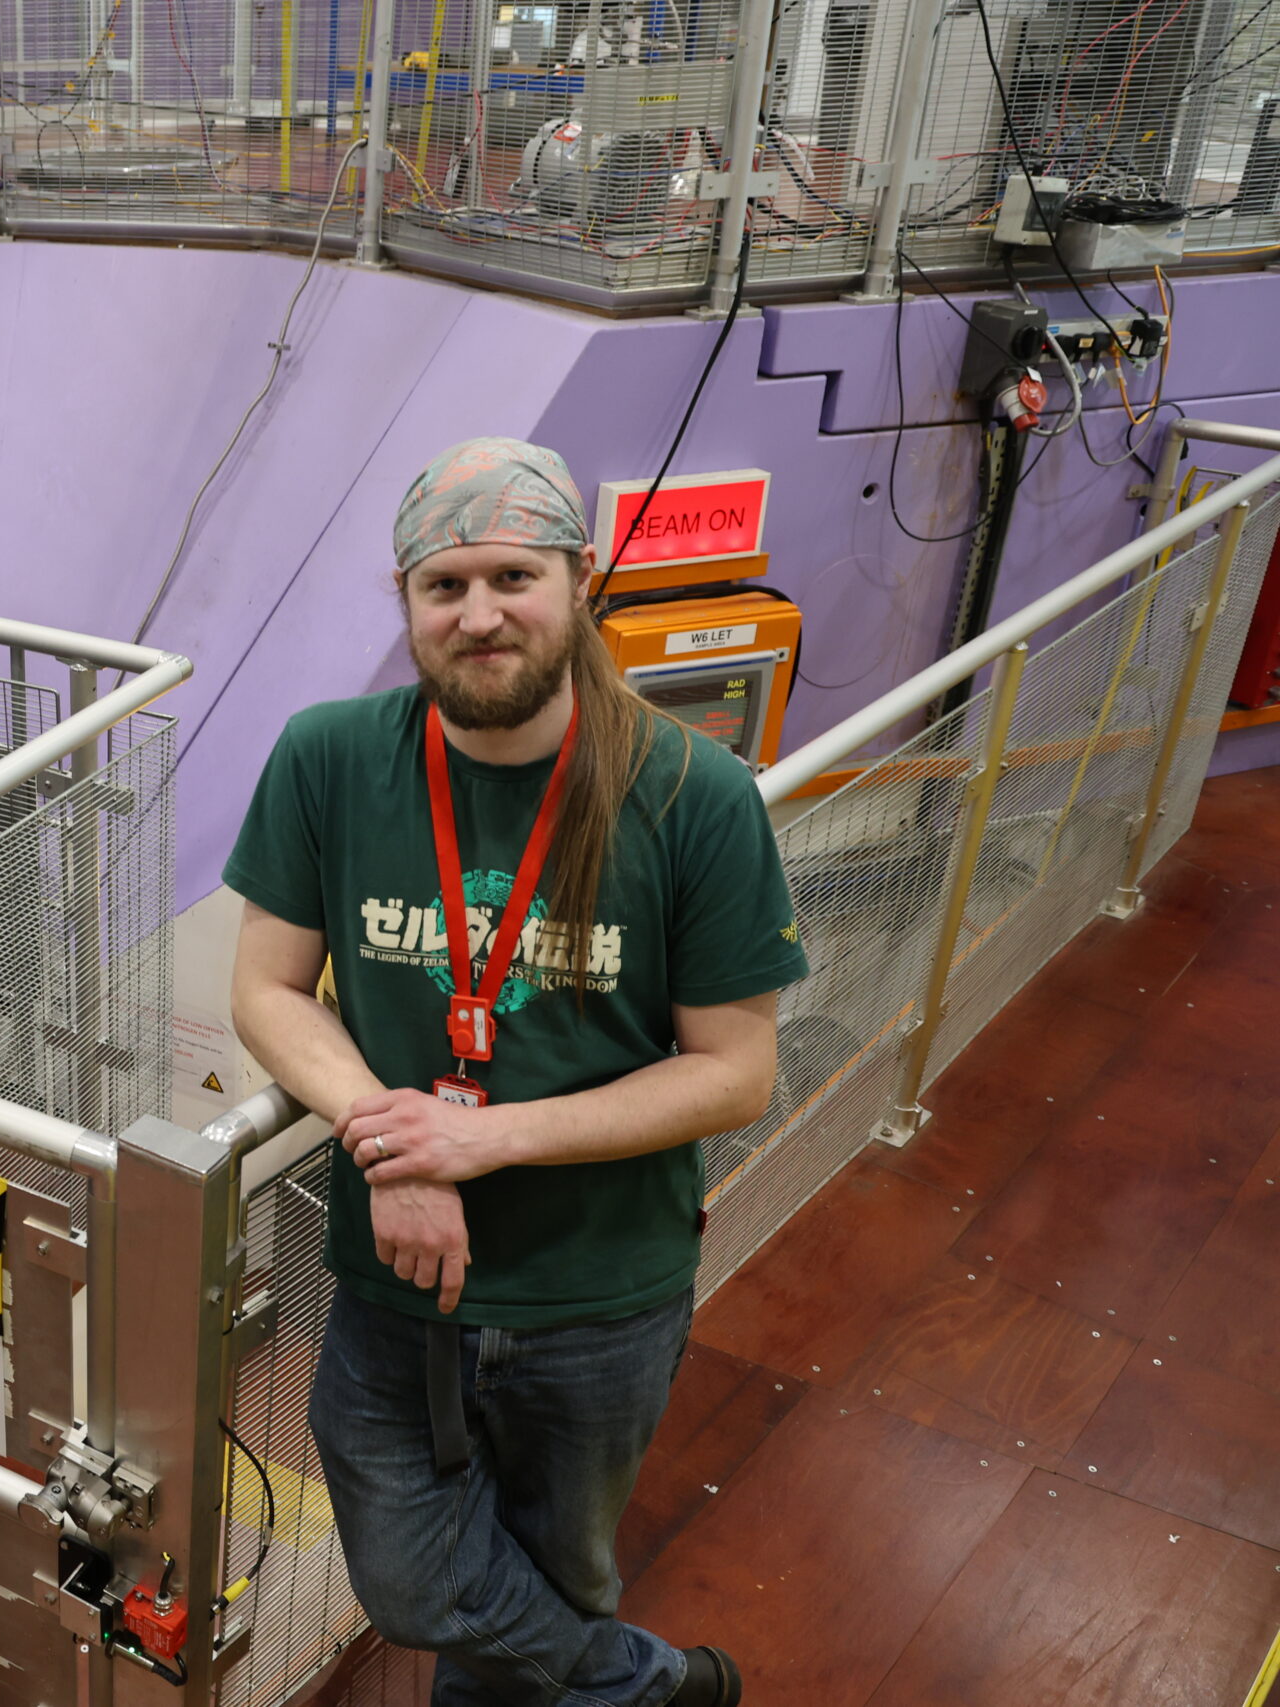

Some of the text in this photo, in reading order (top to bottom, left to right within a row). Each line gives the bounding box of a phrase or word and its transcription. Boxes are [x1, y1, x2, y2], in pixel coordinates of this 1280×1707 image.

[630, 507, 746, 540] BEAM ON
[691, 629, 734, 644] W6 LET
[727, 679, 746, 689] RAD
[724, 689, 746, 700] HIGH
[359, 948, 449, 967] THE LEGEND OF ZELDA
[472, 961, 524, 980] TRS
[541, 973, 619, 993] KINDOM
